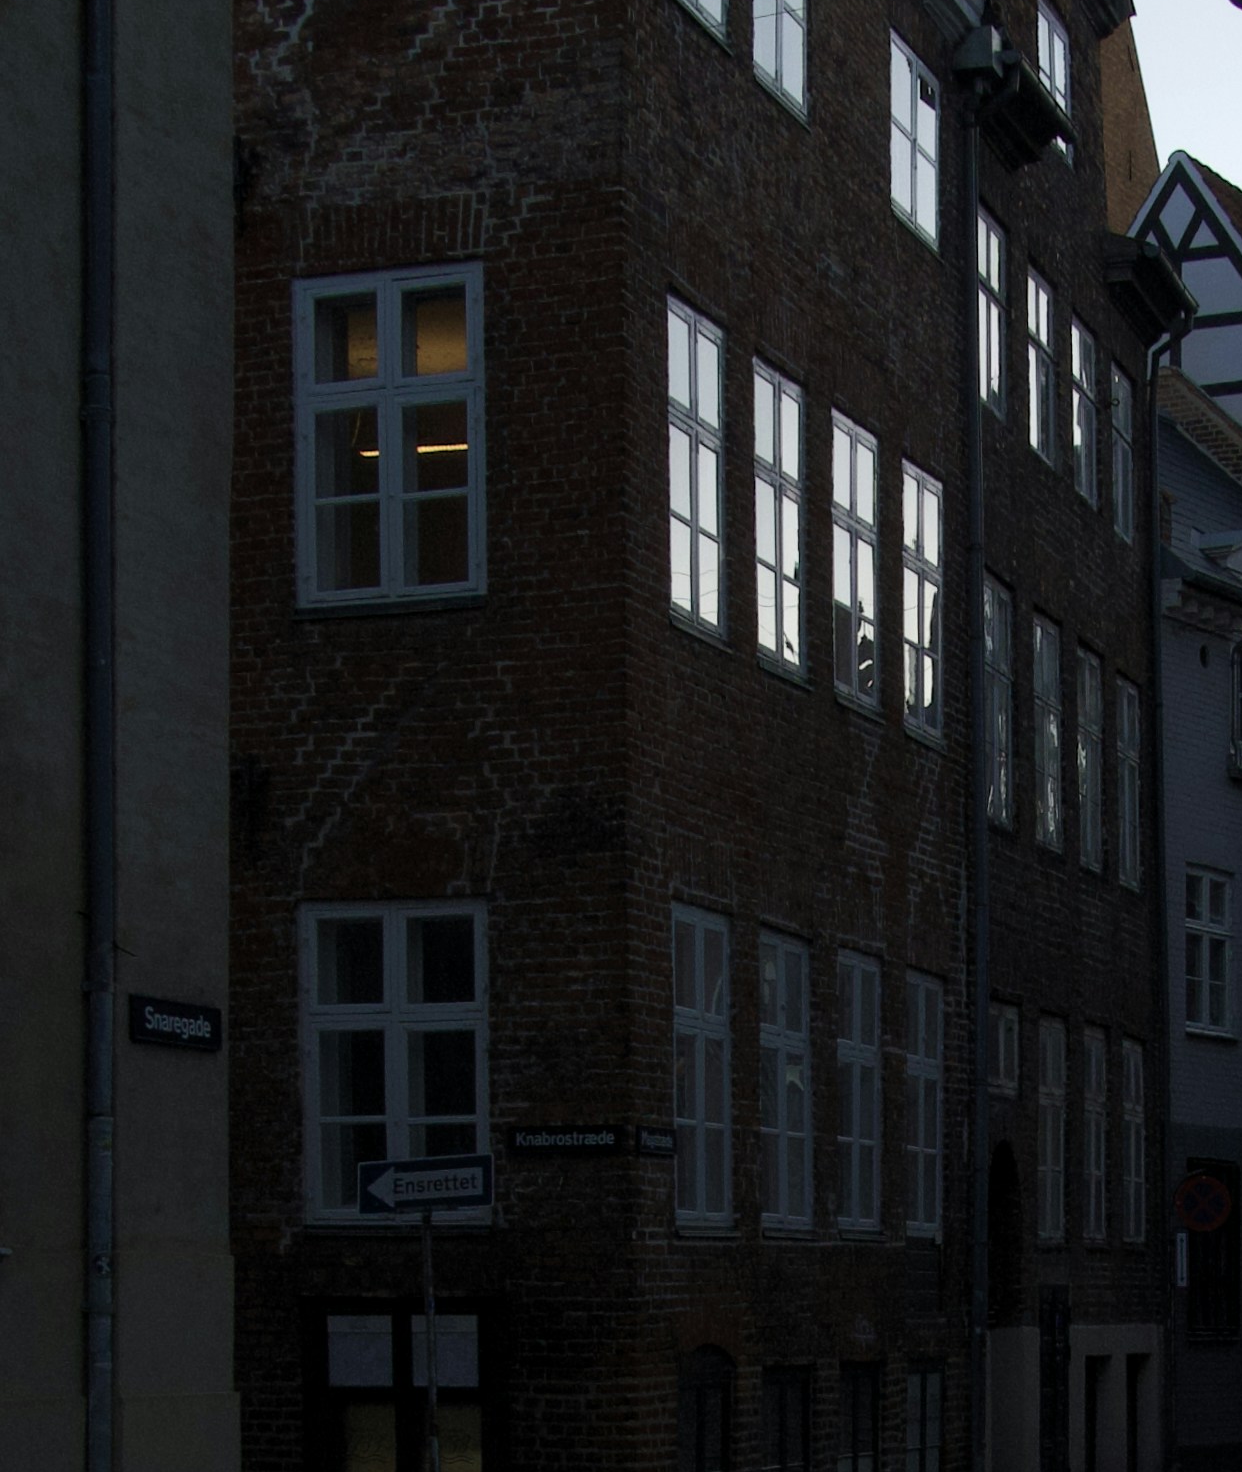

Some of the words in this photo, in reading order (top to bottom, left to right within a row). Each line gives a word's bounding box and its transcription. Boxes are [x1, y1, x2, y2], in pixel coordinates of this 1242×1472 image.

[144, 1005, 212, 1039] Snaregade
[515, 1130, 615, 1146] Knabrostræde
[393, 1172, 477, 1195] Ensrettet
